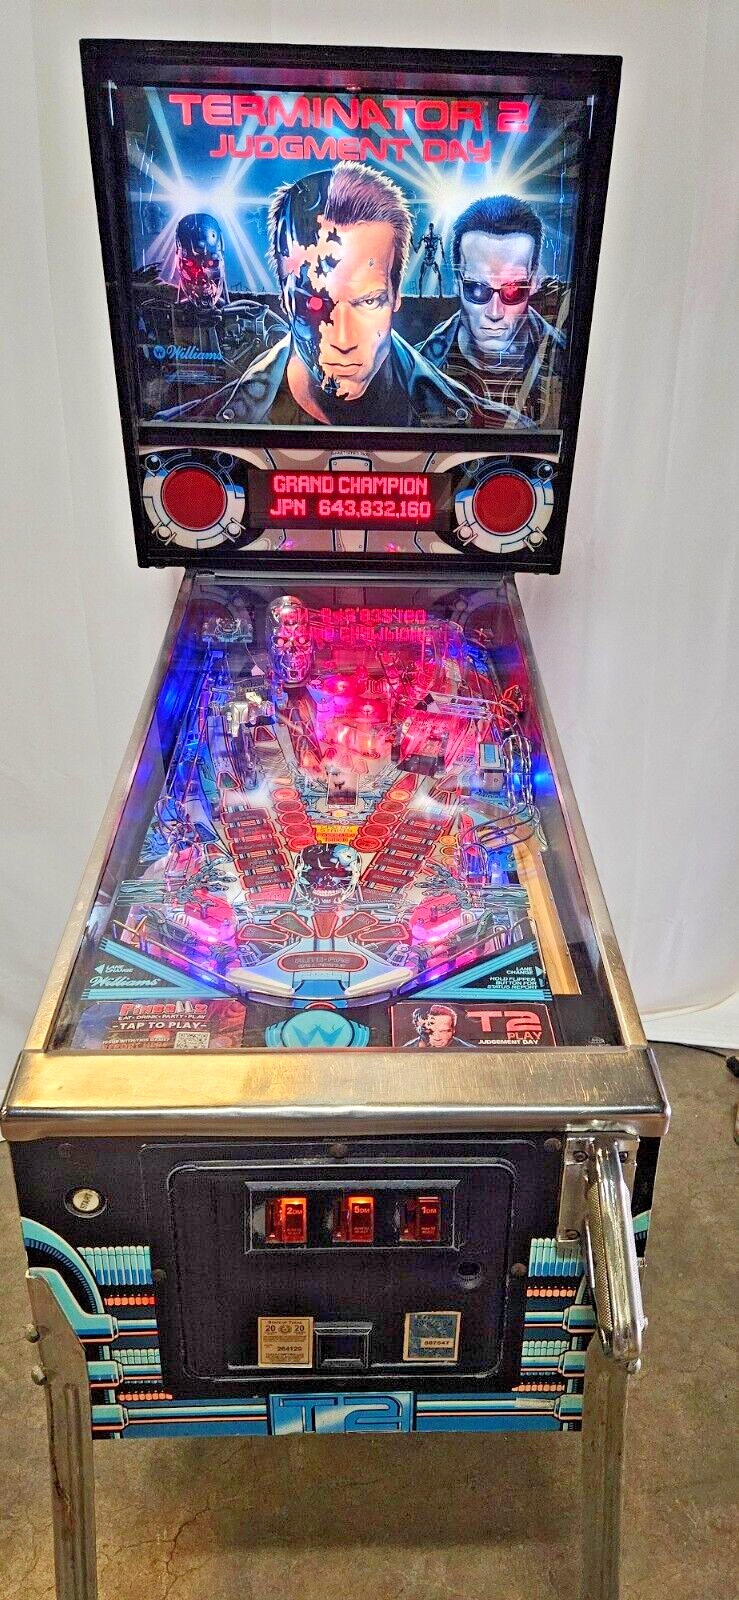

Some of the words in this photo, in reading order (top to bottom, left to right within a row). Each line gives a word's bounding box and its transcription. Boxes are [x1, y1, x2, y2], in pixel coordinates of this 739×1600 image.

[169, 94, 482, 131] TERMINATOR
[498, 101, 529, 132] 2
[210, 134, 411, 162] JUDGMENT
[423, 138, 491, 163] DAY
[166, 344, 224, 360] Williams
[273, 475, 334, 494] GRAND
[338, 476, 427, 496] CHAMPION
[270, 498, 306, 516] JPN
[318, 499, 431, 518] 643,832,160
[90, 976, 161, 987] Williams
[466, 1010, 542, 1032] T2
[507, 1032, 542, 1040] PLAY
[279, 1396, 402, 1433] T2
